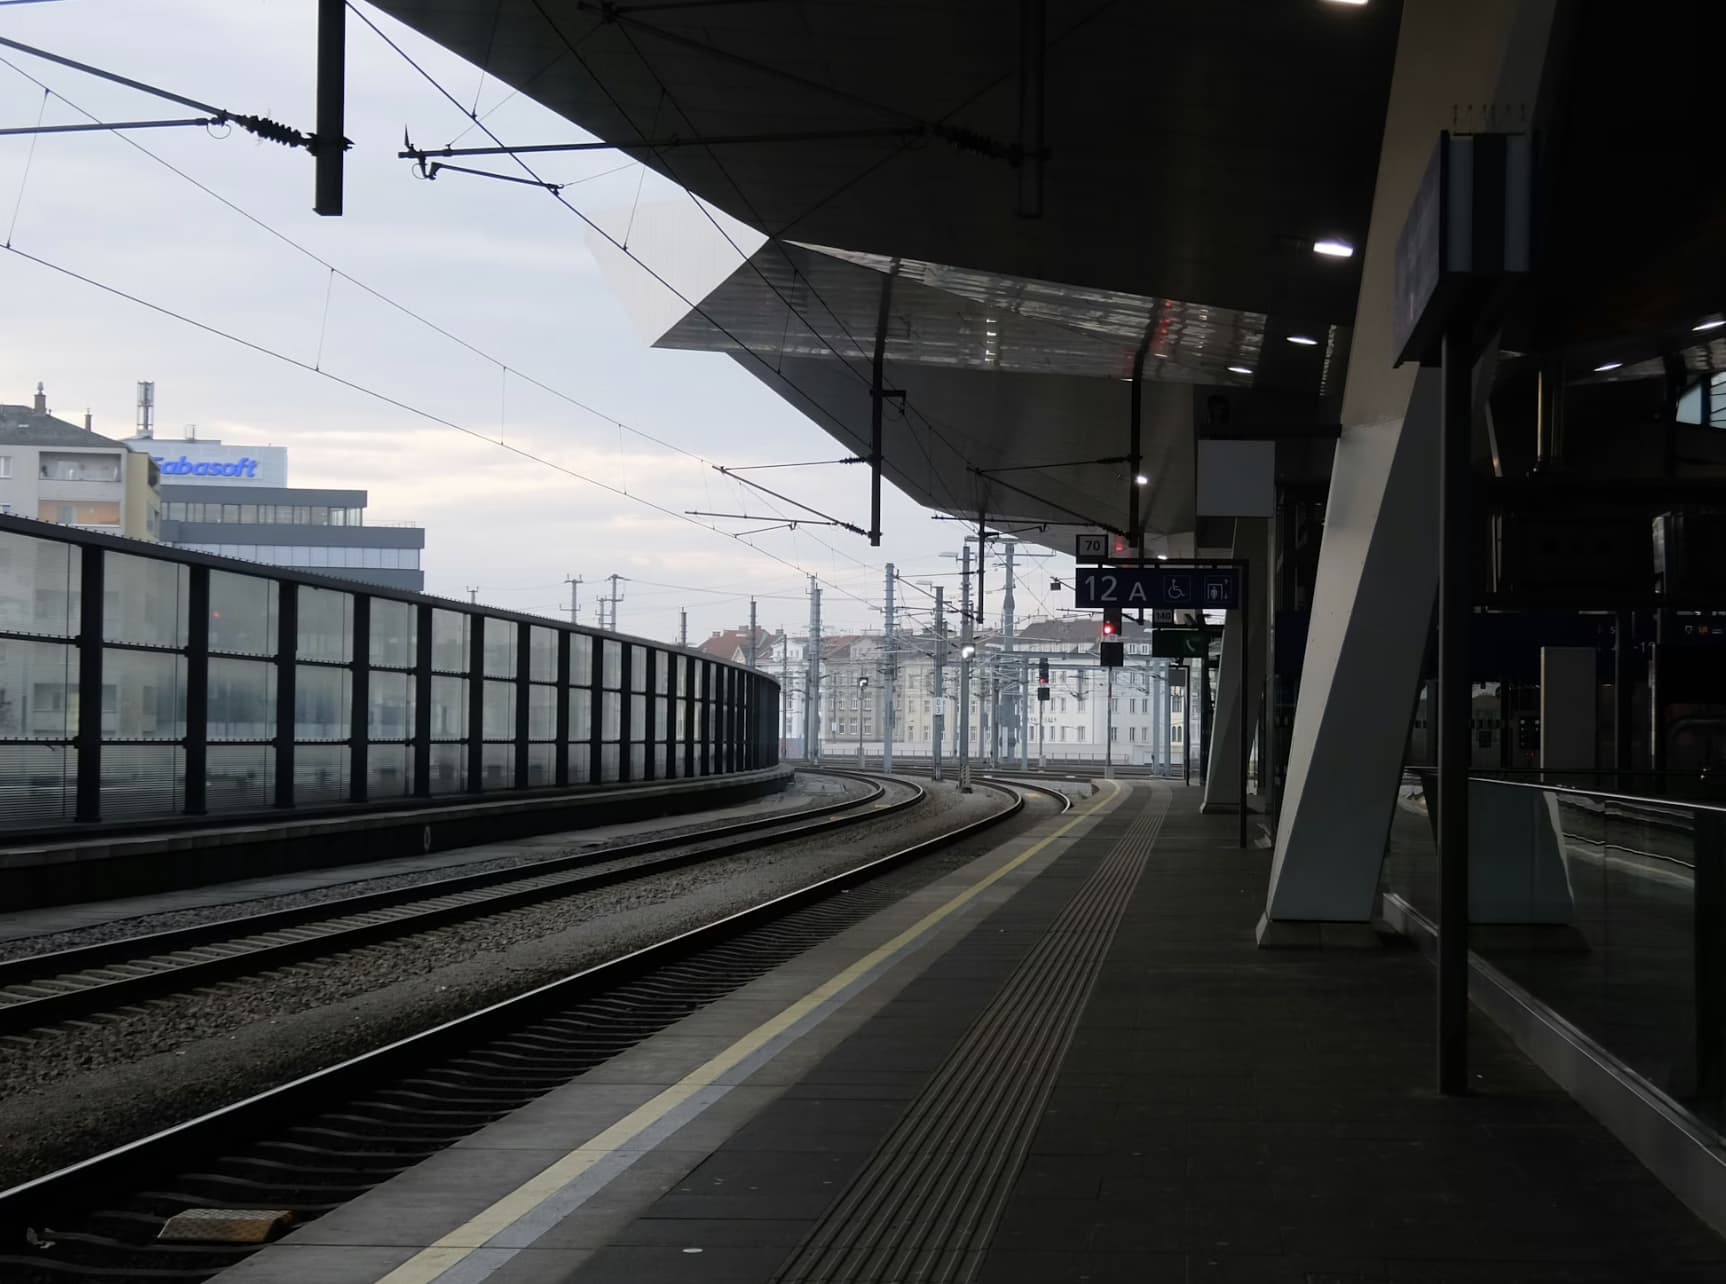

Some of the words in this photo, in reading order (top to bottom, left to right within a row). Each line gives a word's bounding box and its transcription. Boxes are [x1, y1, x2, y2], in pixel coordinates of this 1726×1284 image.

[1085, 540, 1100, 551] 70
[1084, 575, 1118, 601] 12
[1128, 581, 1147, 601] A
